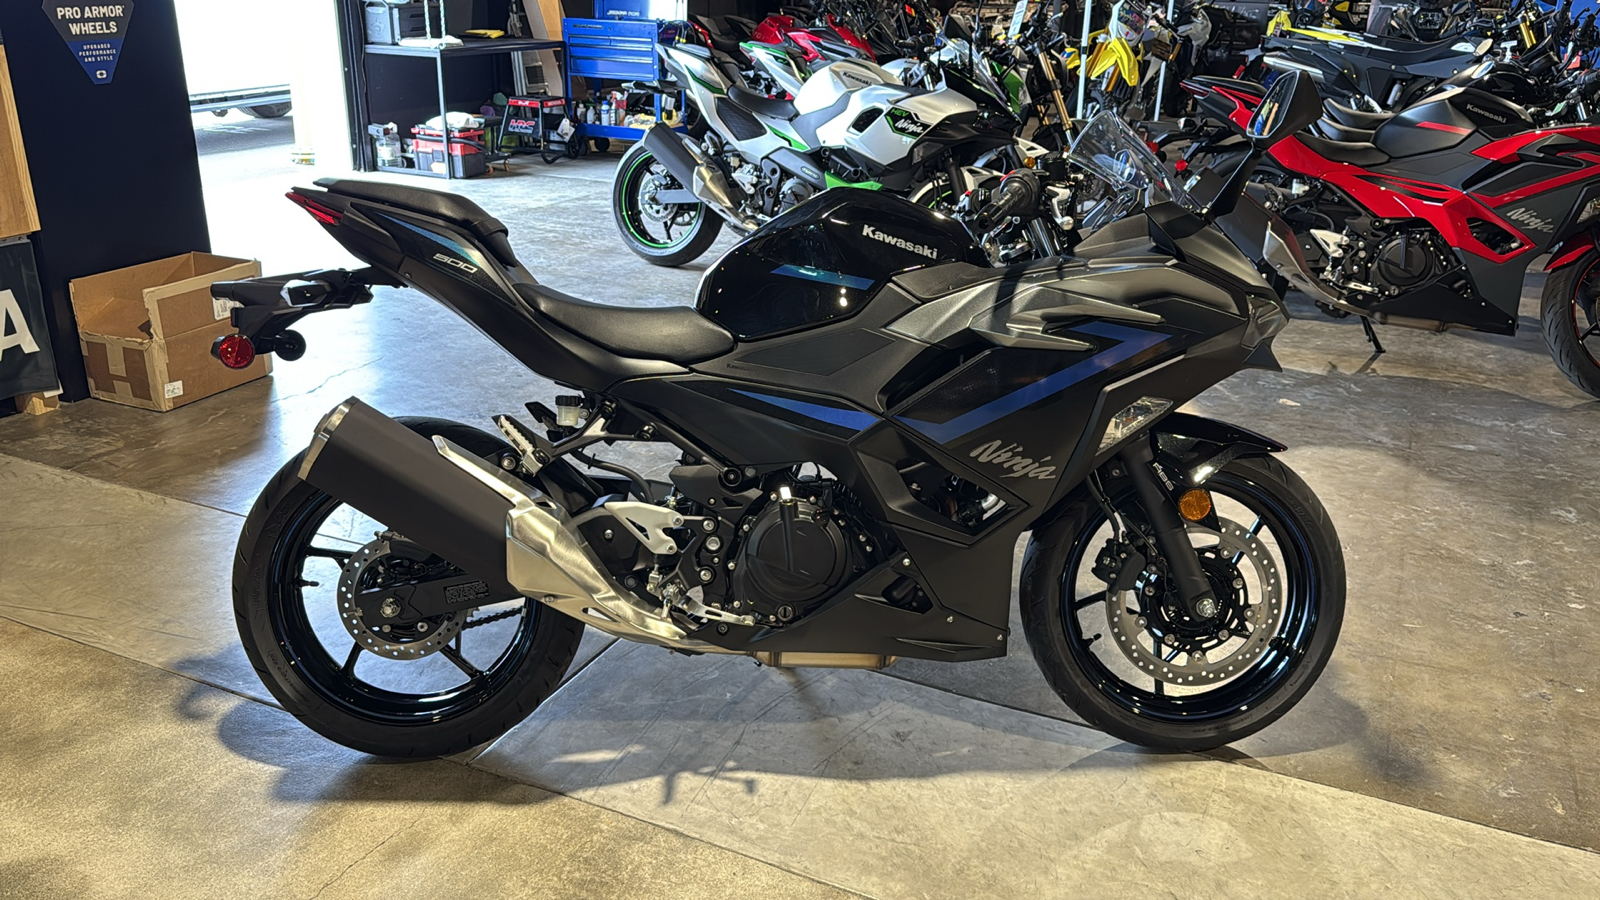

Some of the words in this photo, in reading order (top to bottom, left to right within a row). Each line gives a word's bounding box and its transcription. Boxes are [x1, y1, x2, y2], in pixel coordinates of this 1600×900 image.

[56, 7, 81, 20] PRO
[68, 21, 118, 35] WHEELS
[79, 49, 116, 57] PERFORMANCE
[842, 71, 872, 87] Kawasaki
[890, 107, 910, 118] HEV
[1466, 103, 1507, 124] Kawasaki
[508, 119, 536, 134] HRC
[895, 119, 924, 134] Ninja
[1506, 207, 1555, 233] Ninja
[862, 224, 938, 260] Kawasaki
[433, 253, 478, 274] 500
[969, 439, 1057, 480] Ninja
[1152, 462, 1175, 491] ABS
